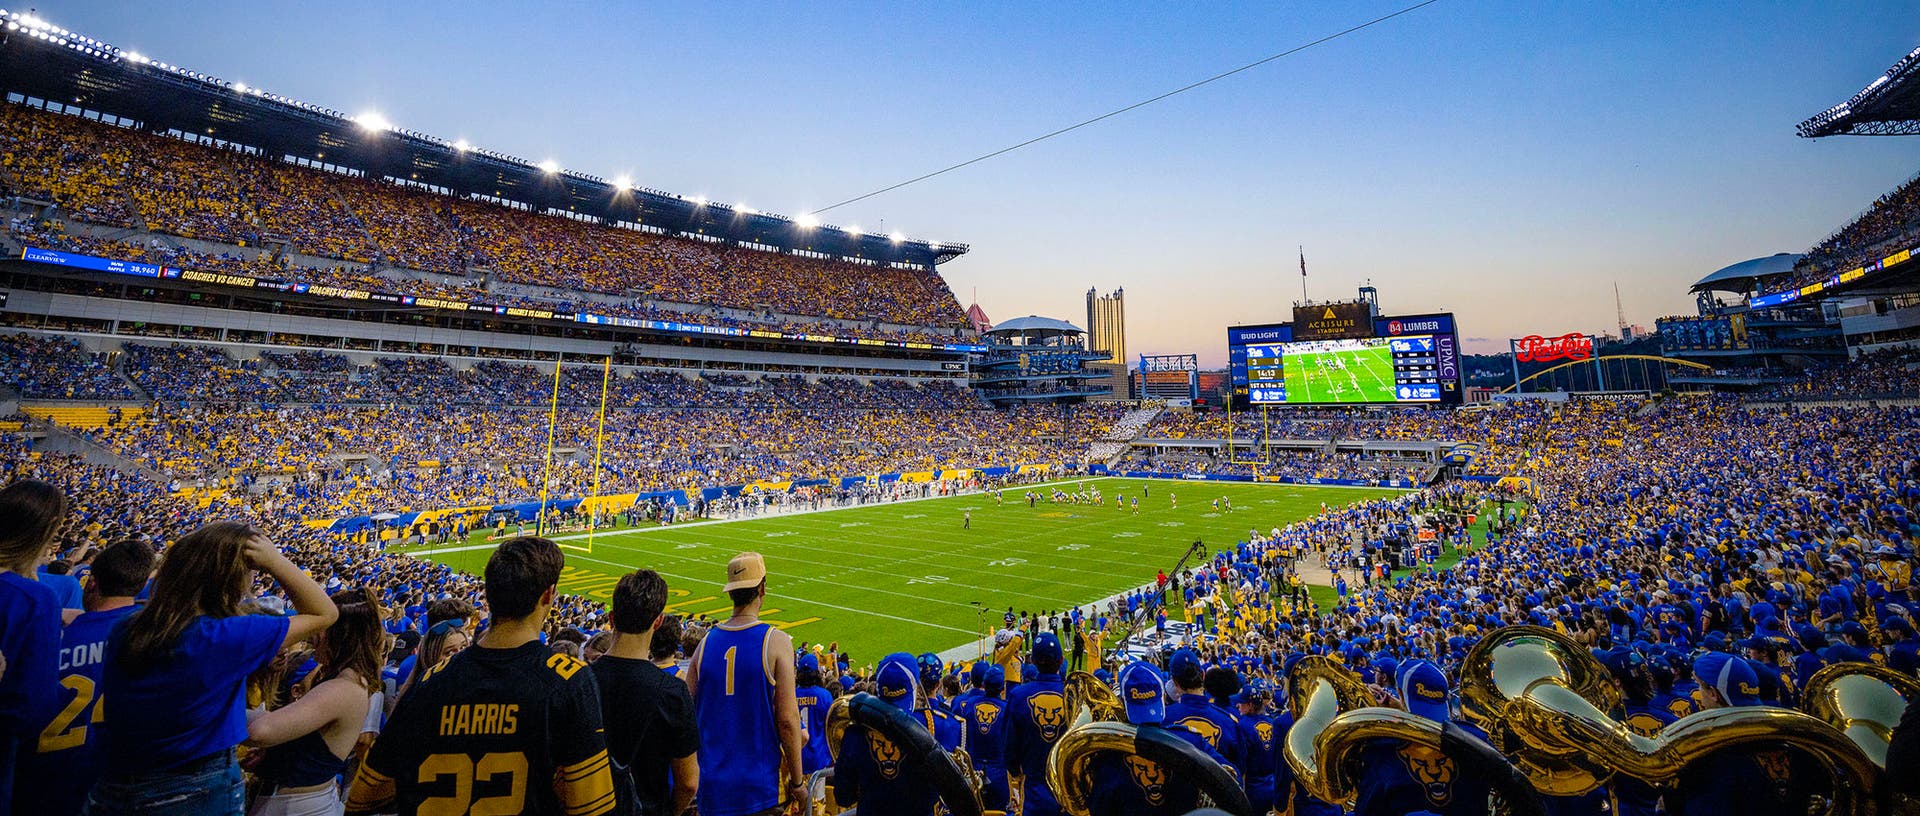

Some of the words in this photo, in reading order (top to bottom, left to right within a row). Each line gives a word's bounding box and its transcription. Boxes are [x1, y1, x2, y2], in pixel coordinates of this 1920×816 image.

[28, 253, 66, 263] CLEARVIEW
[130, 265, 155, 274] 38,960
[182, 270, 217, 282] COACHES
[217, 275, 227, 284] VS
[226, 275, 256, 287] CANCER
[308, 285, 336, 297] COACHES
[337, 289, 346, 298] VS
[345, 289, 371, 300] CANCER
[415, 298, 440, 307] COACHES
[440, 300, 447, 308] VS
[446, 301, 468, 311] CANCER
[506, 307, 529, 317] COACHES
[528, 309, 535, 317] VS
[534, 310, 553, 319] CANCER
[1308, 319, 1355, 329] ACRISURE
[1390, 323, 1401, 332] 84
[1403, 321, 1439, 331] LUMBER
[1257, 331, 1279, 339] LIGHT
[1252, 358, 1258, 366] 3
[1440, 338, 1455, 376] UPMC
[1149, 359, 1197, 371] PEOPLES
[1257, 369, 1276, 377] 14:13
[906, 575, 950, 585] 10
[58, 640, 109, 671] CON
[724, 645, 737, 696] 1
[439, 703, 520, 736] HARRIS
